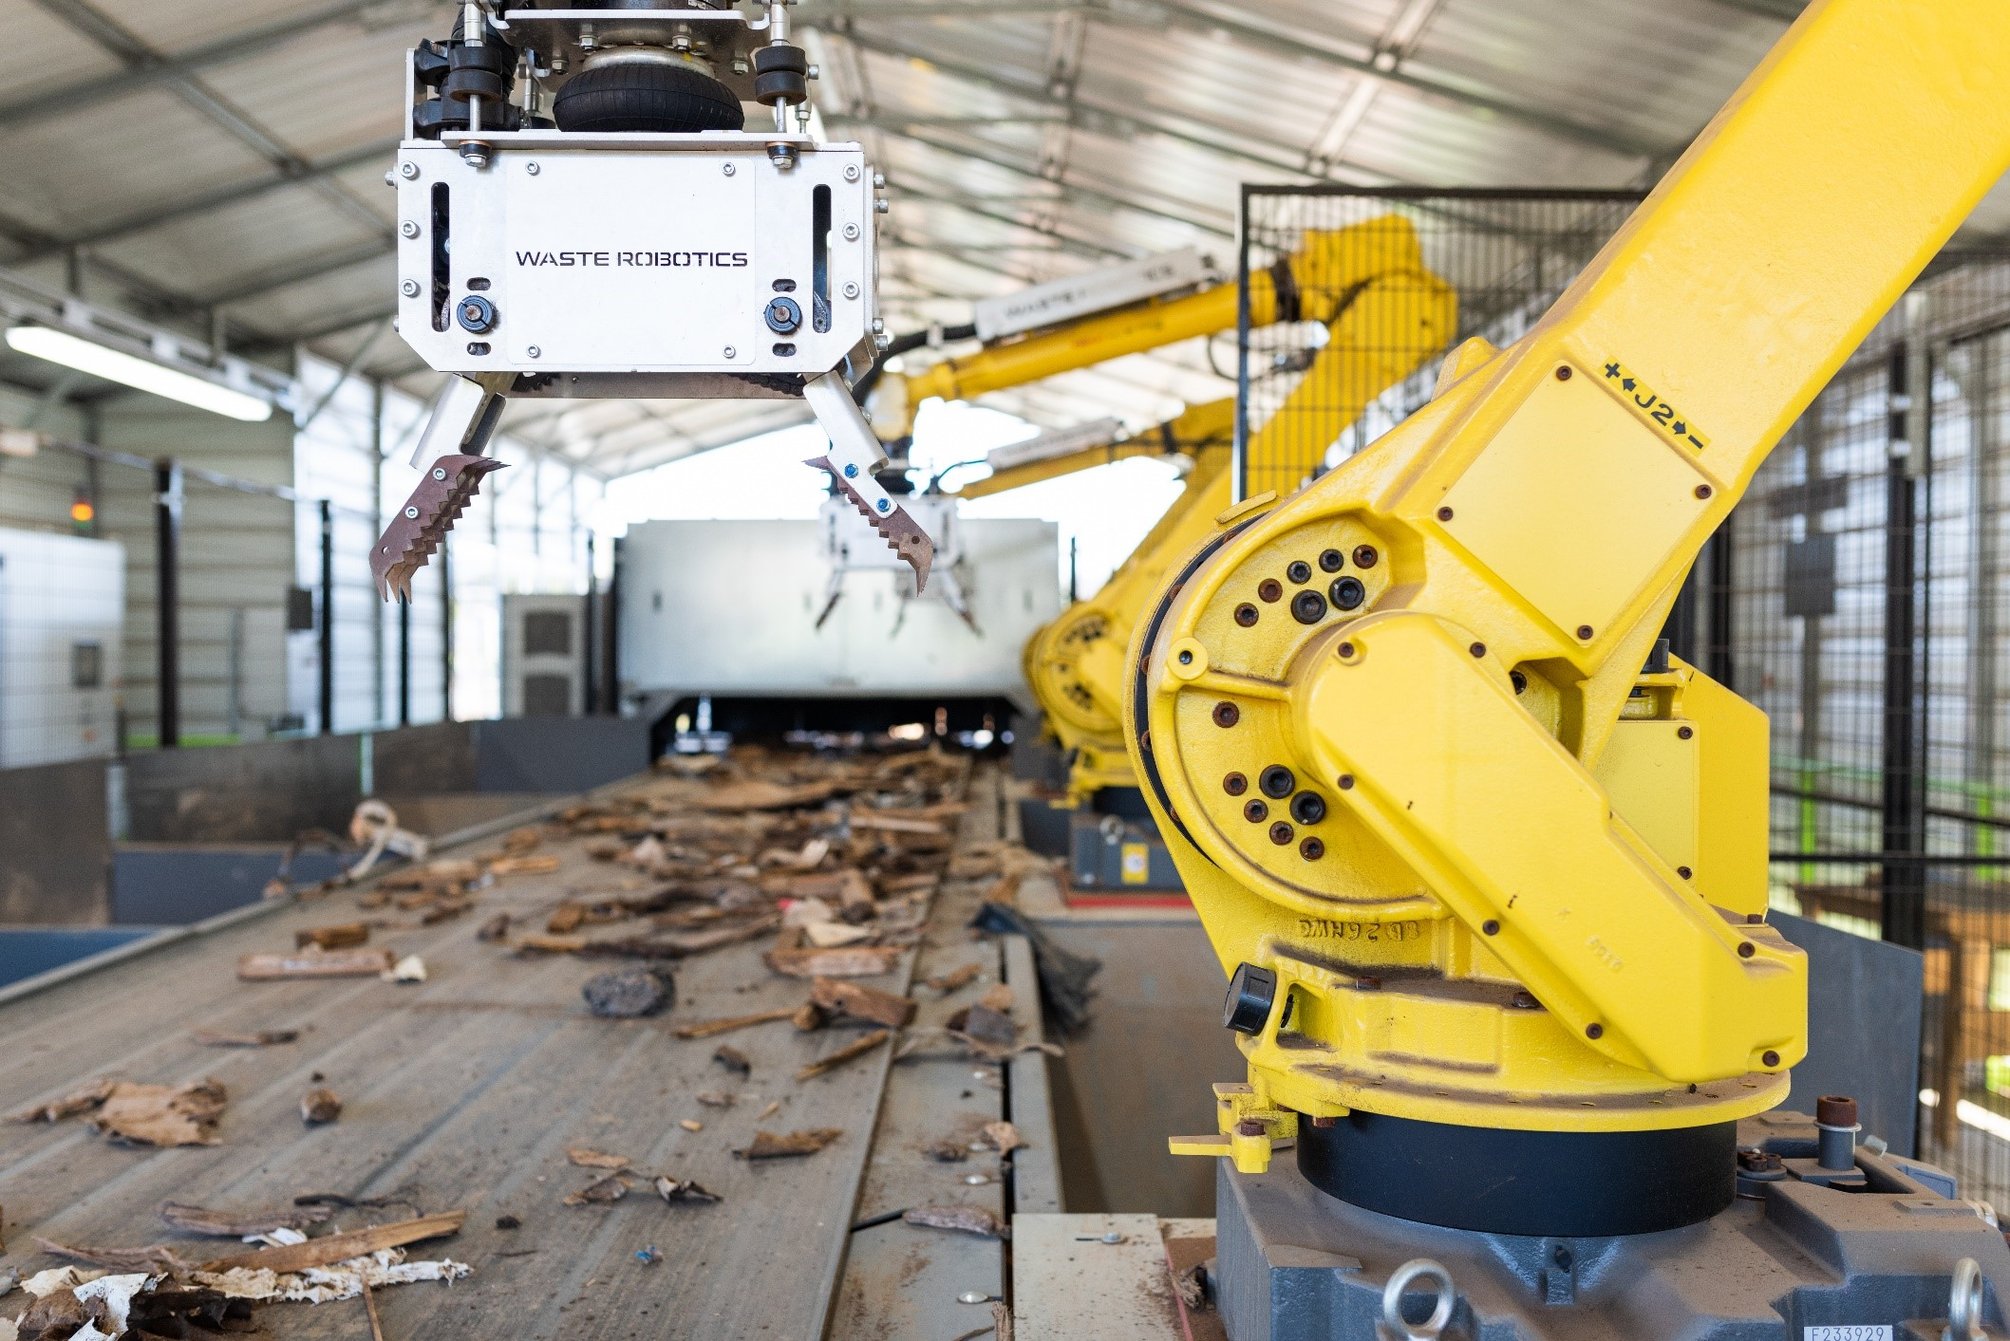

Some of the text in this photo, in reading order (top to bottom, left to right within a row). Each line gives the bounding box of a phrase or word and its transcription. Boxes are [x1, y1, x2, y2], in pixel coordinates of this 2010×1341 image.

[515, 251, 748, 267] WASTE ROBOTICS
[1634, 393, 1674, 427] J2
[1811, 1326, 1884, 1341] F233929
